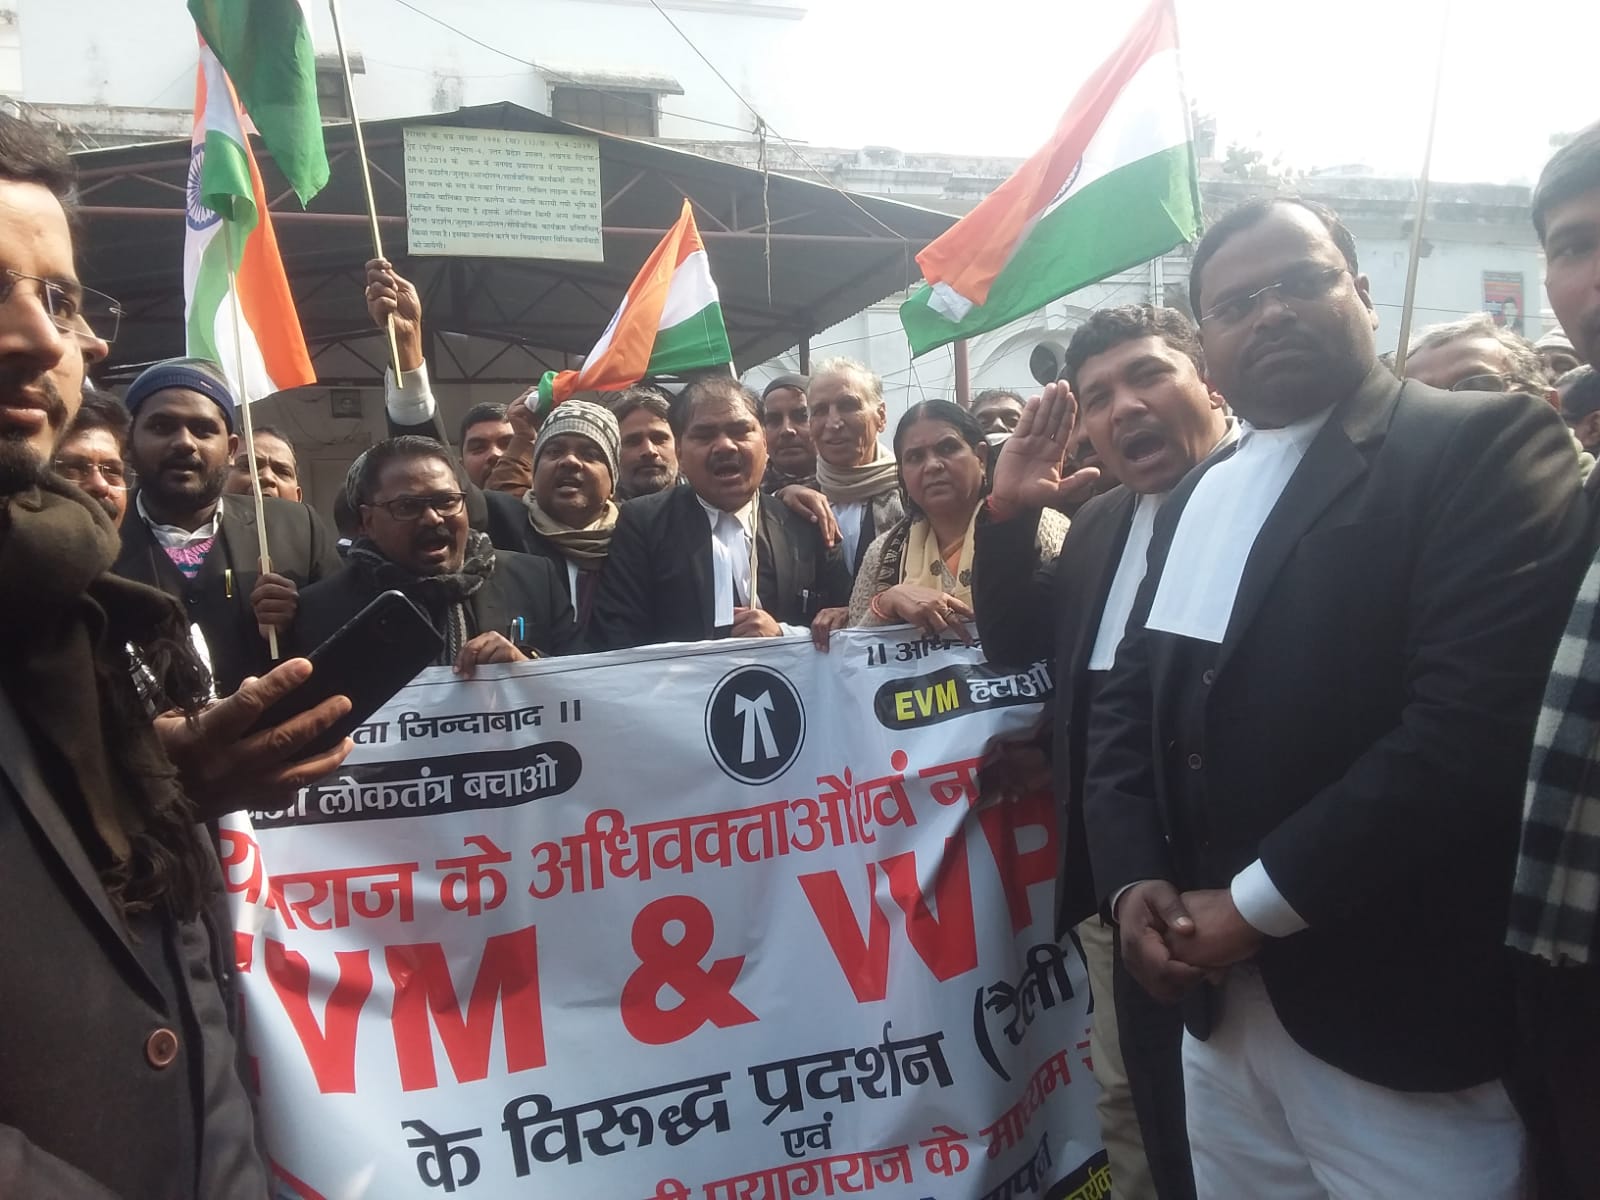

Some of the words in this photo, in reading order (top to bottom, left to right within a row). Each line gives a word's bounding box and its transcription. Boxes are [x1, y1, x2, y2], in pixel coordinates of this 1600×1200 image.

[400, 703, 544, 742] जिन्दाबाद
[895, 679, 960, 721] EVM
[318, 765, 454, 816] लोकतंत्र
[462, 752, 559, 800] बचाओ
[435, 834, 513, 917] के
[528, 766, 858, 900] अधिवक्ताओं
[854, 749, 918, 844] एवं
[232, 924, 547, 1097] VM
[620, 896, 760, 1045] &
[401, 1119, 483, 1194] के
[748, 1020, 954, 1127] प्रदर्शन
[780, 1111, 834, 1159] एवं
[919, 1125, 970, 1178] के
